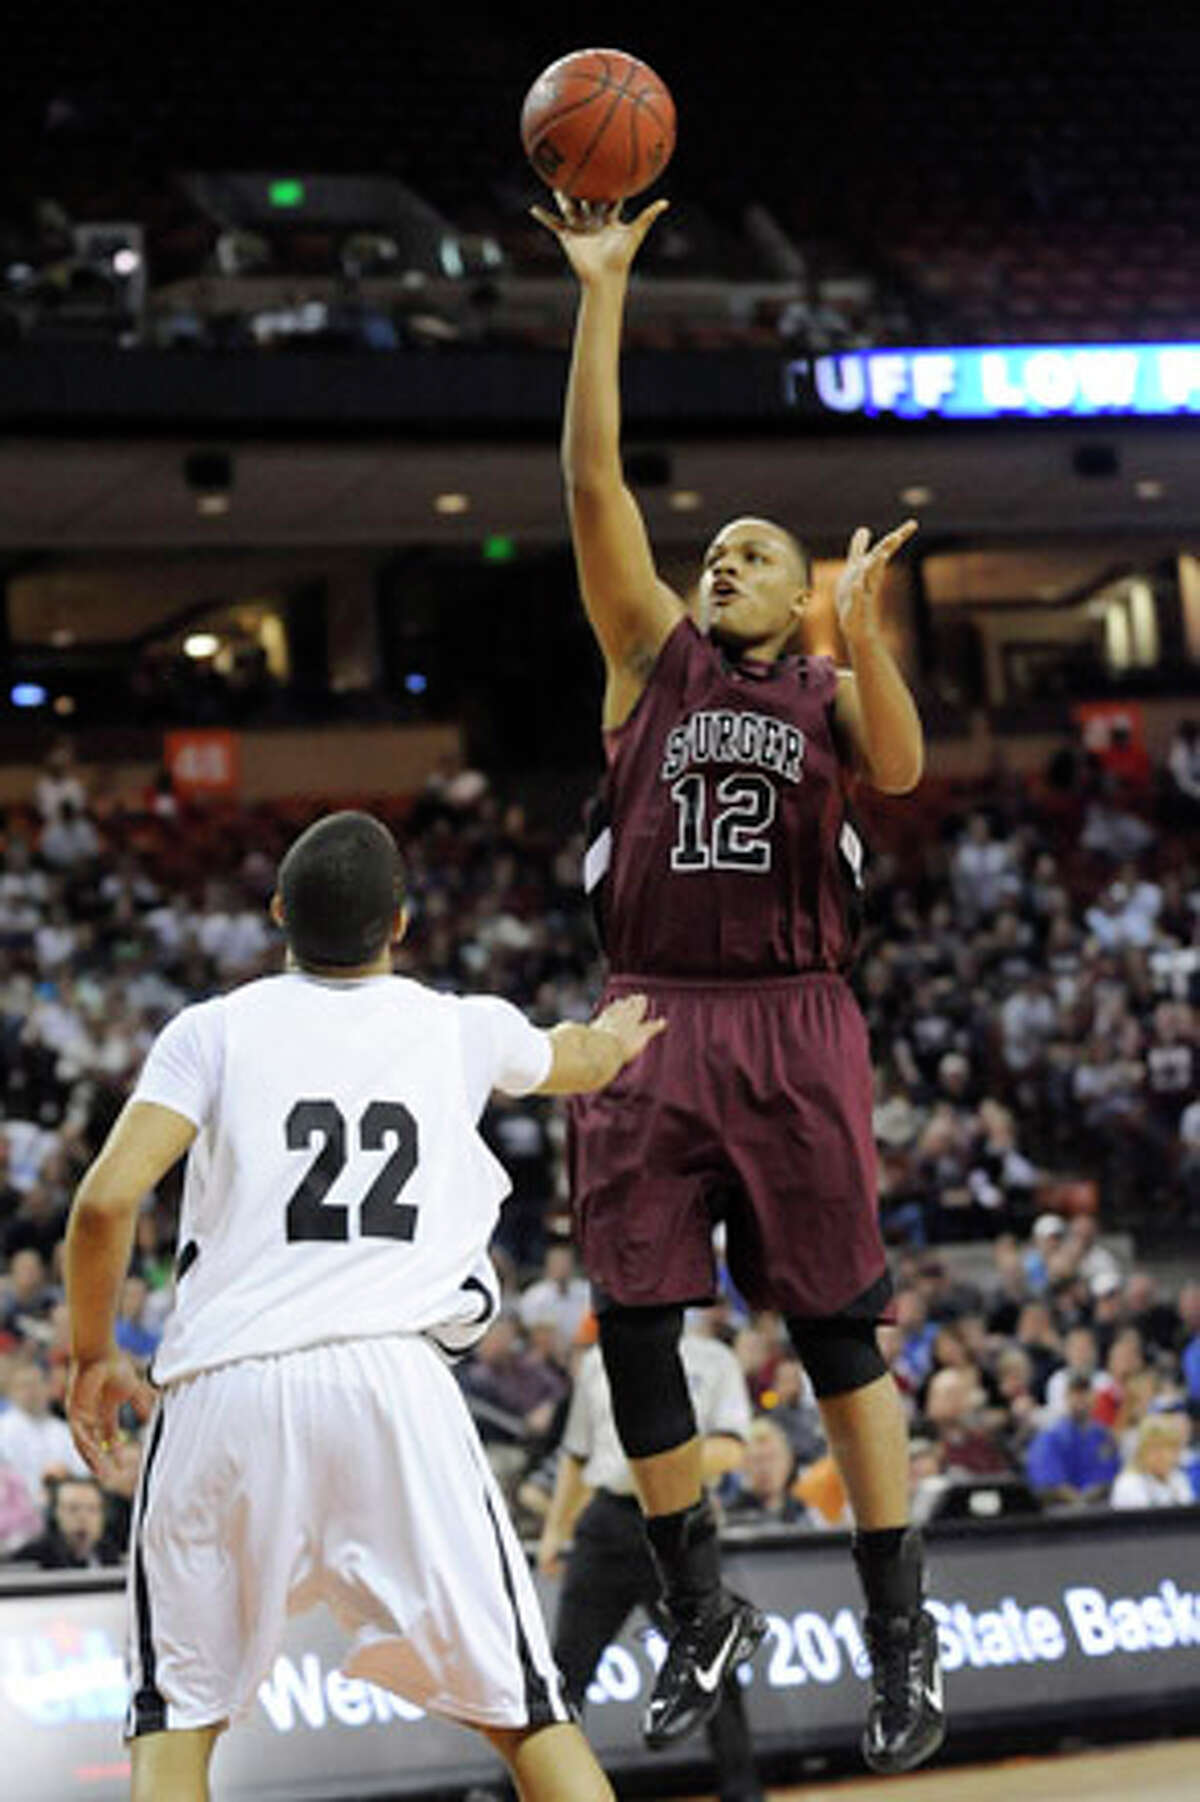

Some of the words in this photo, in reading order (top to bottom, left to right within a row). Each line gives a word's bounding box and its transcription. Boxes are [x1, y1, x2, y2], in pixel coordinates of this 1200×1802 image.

[981, 350, 1137, 410] LOW
[670, 772, 776, 874] 12
[285, 1099, 418, 1244] 22
[762, 1609, 874, 1686] 201
[921, 1597, 1067, 1672] State
